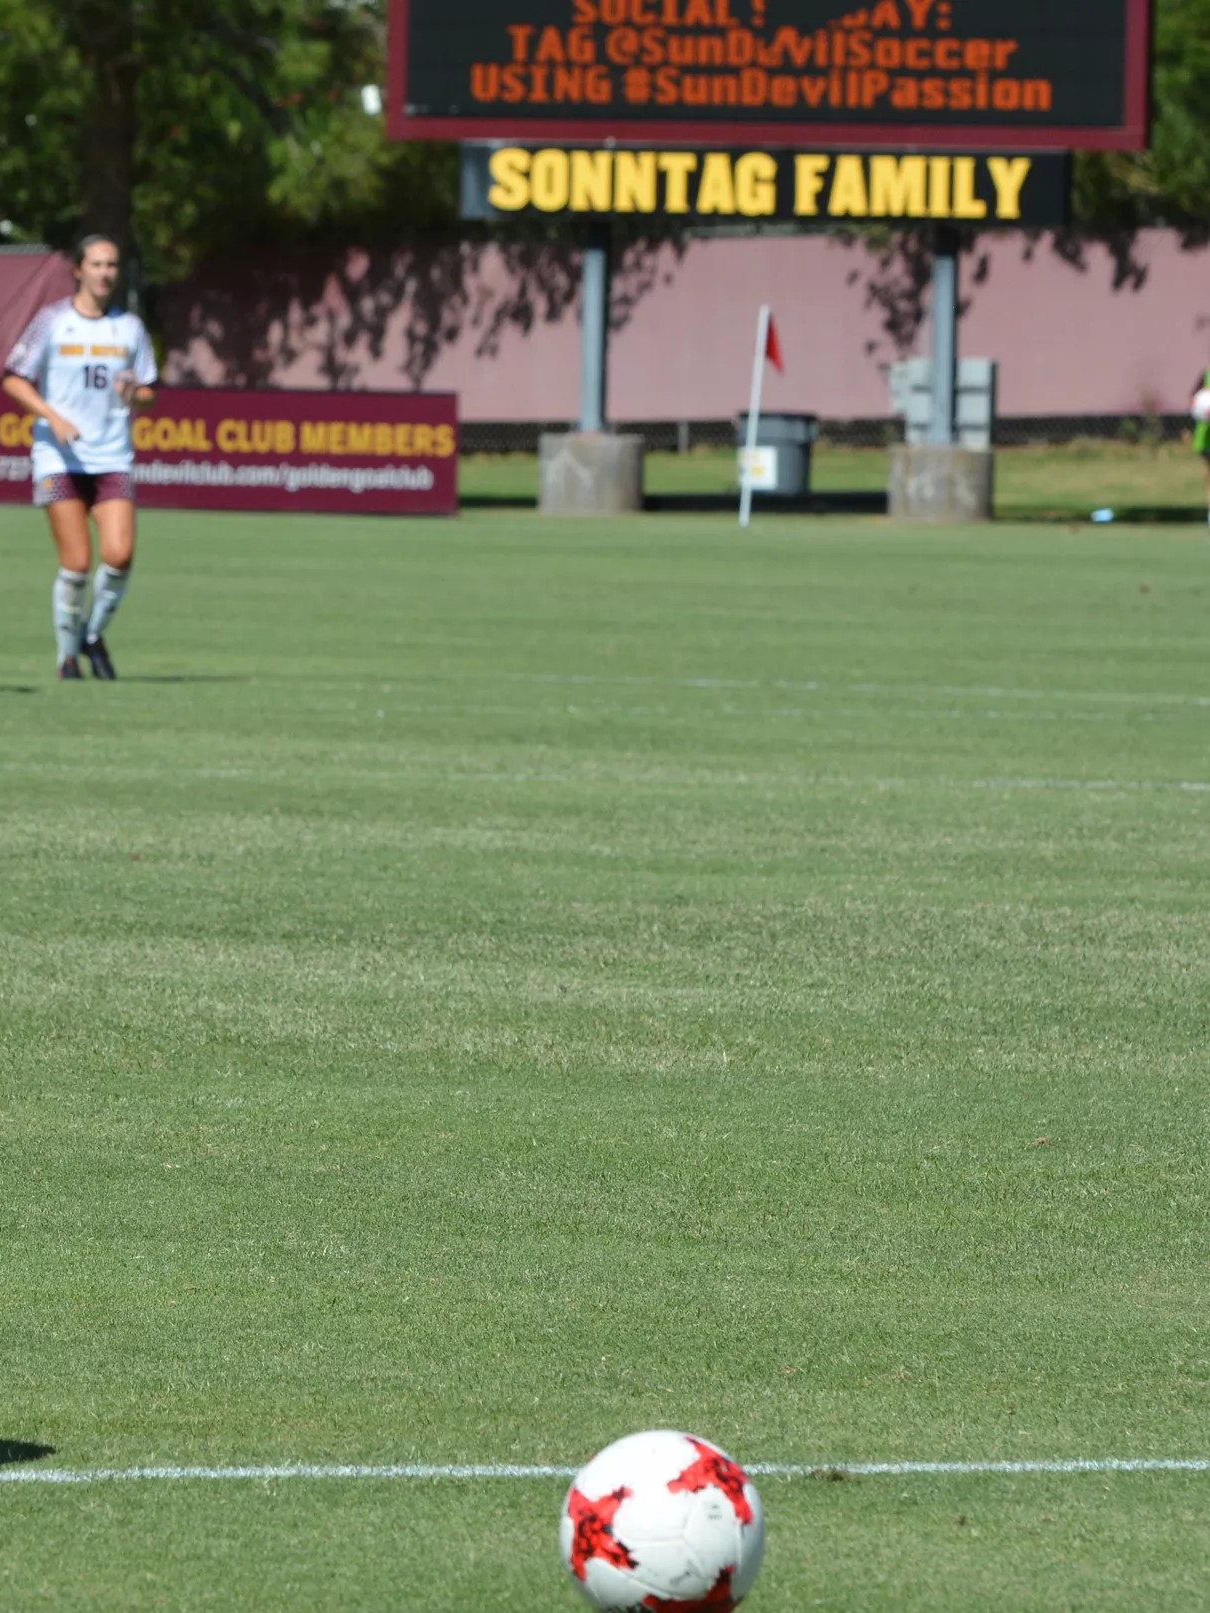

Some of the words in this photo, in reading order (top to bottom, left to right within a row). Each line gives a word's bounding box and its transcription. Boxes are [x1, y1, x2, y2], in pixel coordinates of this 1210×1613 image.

[573, 0, 739, 26] SOCIAL
[506, 24, 597, 64] TAG
[471, 62, 612, 104] USING
[624, 65, 1052, 111] #SunDevilPassion
[489, 147, 778, 215] SONNTAG
[794, 154, 1031, 219] FAMILY
[84, 364, 108, 390] 16
[131, 416, 212, 452] GOAL
[216, 419, 296, 454] CLUB
[300, 421, 456, 458] MEMBERS
